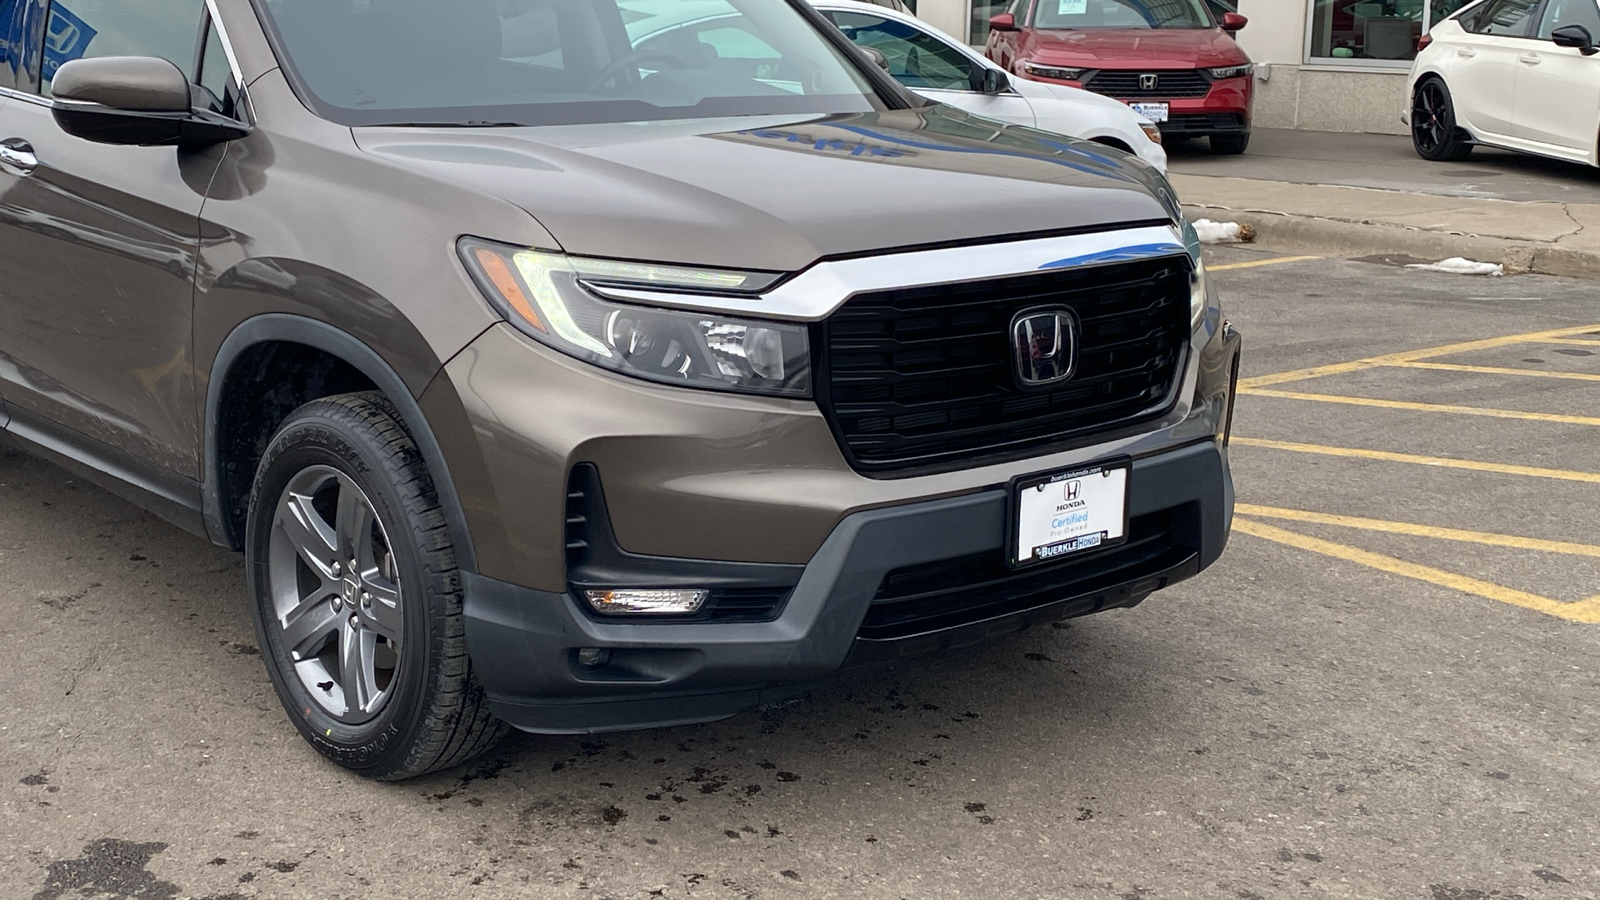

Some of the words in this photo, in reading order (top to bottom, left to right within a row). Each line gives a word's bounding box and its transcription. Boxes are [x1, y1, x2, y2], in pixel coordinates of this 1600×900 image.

[1143, 110, 1167, 118] HONDA
[1056, 500, 1085, 511] HONDA
[1051, 513, 1088, 528] Certified
[1050, 524, 1088, 537] Pre-Owned
[1041, 541, 1078, 557] BUERKLE
[1078, 536, 1100, 549] HONDA
